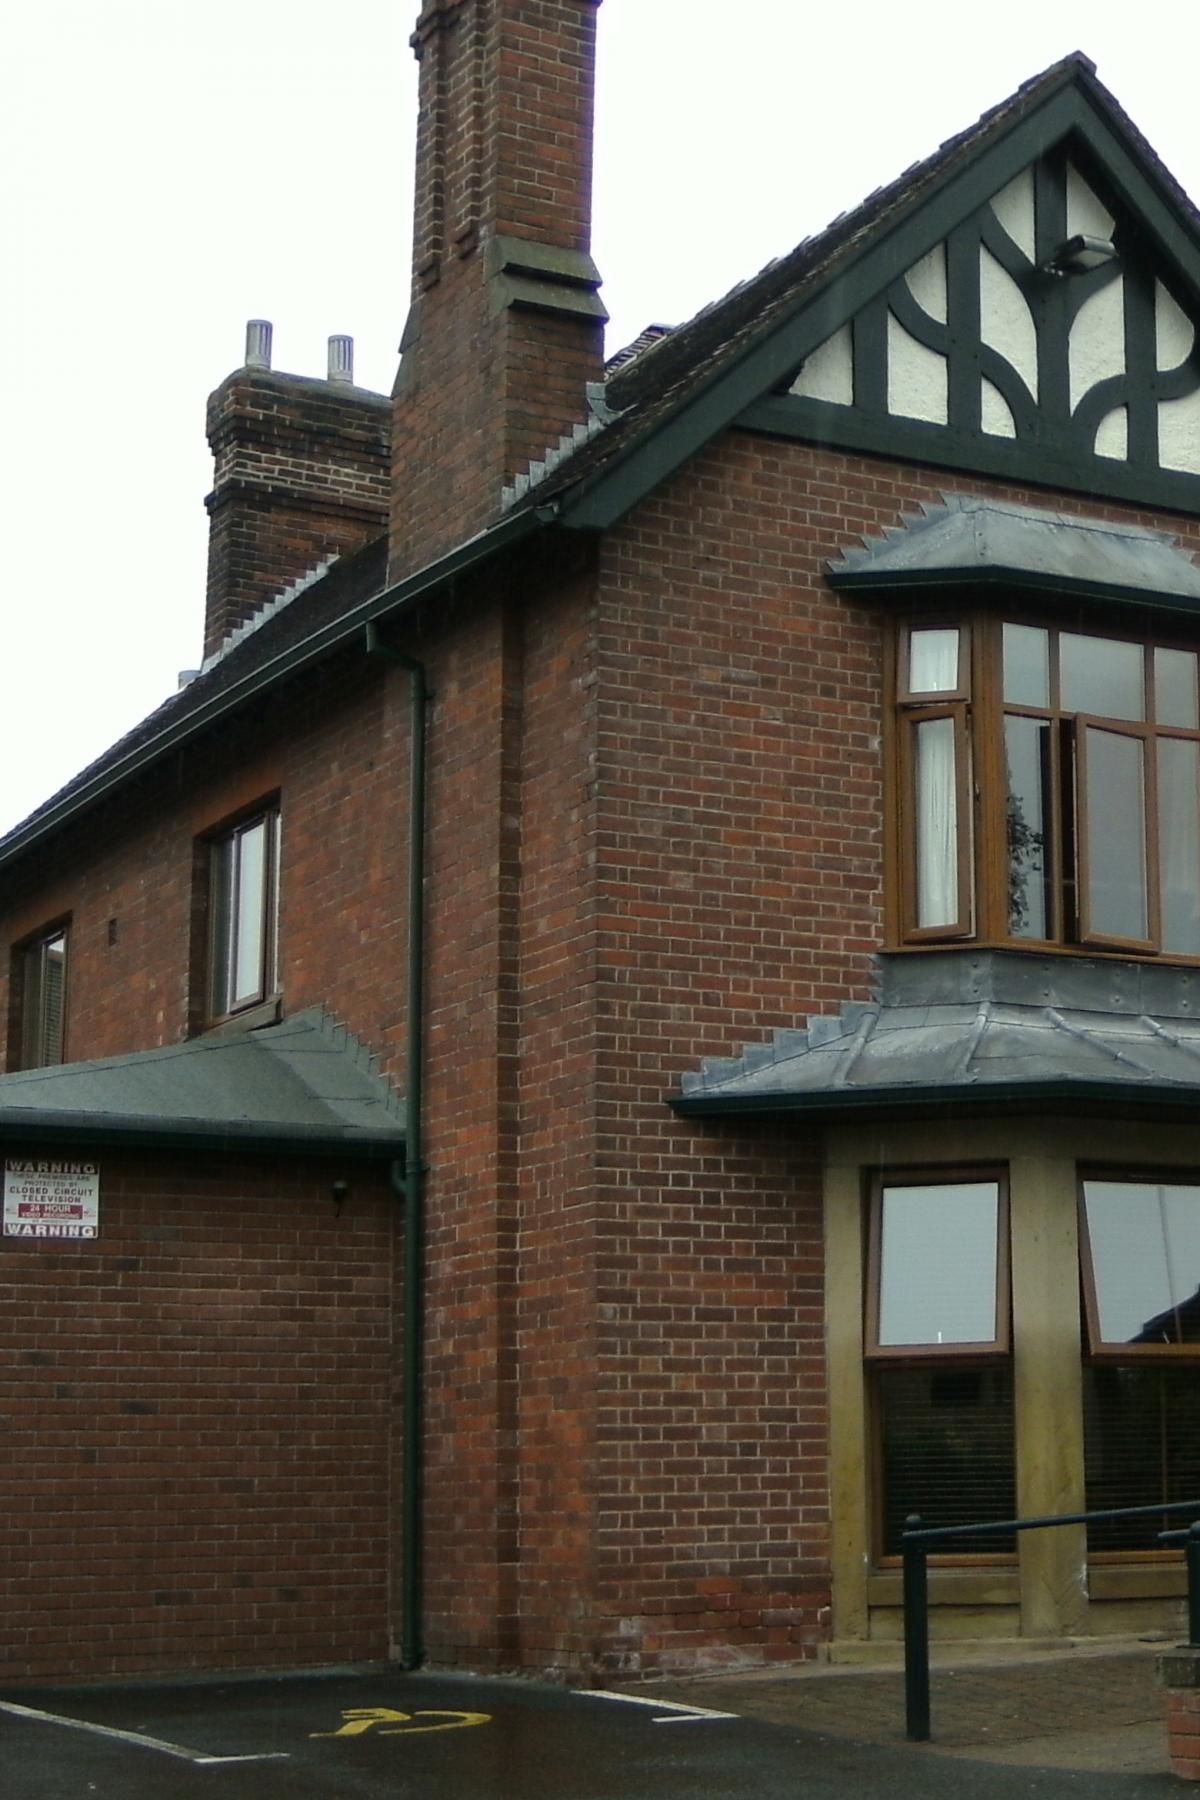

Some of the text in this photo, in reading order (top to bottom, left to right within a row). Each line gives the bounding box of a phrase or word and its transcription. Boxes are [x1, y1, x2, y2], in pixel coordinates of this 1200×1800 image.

[9, 1161, 96, 1174] WARNING
[9, 1186, 94, 1197] CLOSED CIRCUIT
[22, 1195, 81, 1203] TELEVISION
[29, 1204, 71, 1213] 24 HOUR
[7, 1223, 95, 1237] WARNING
